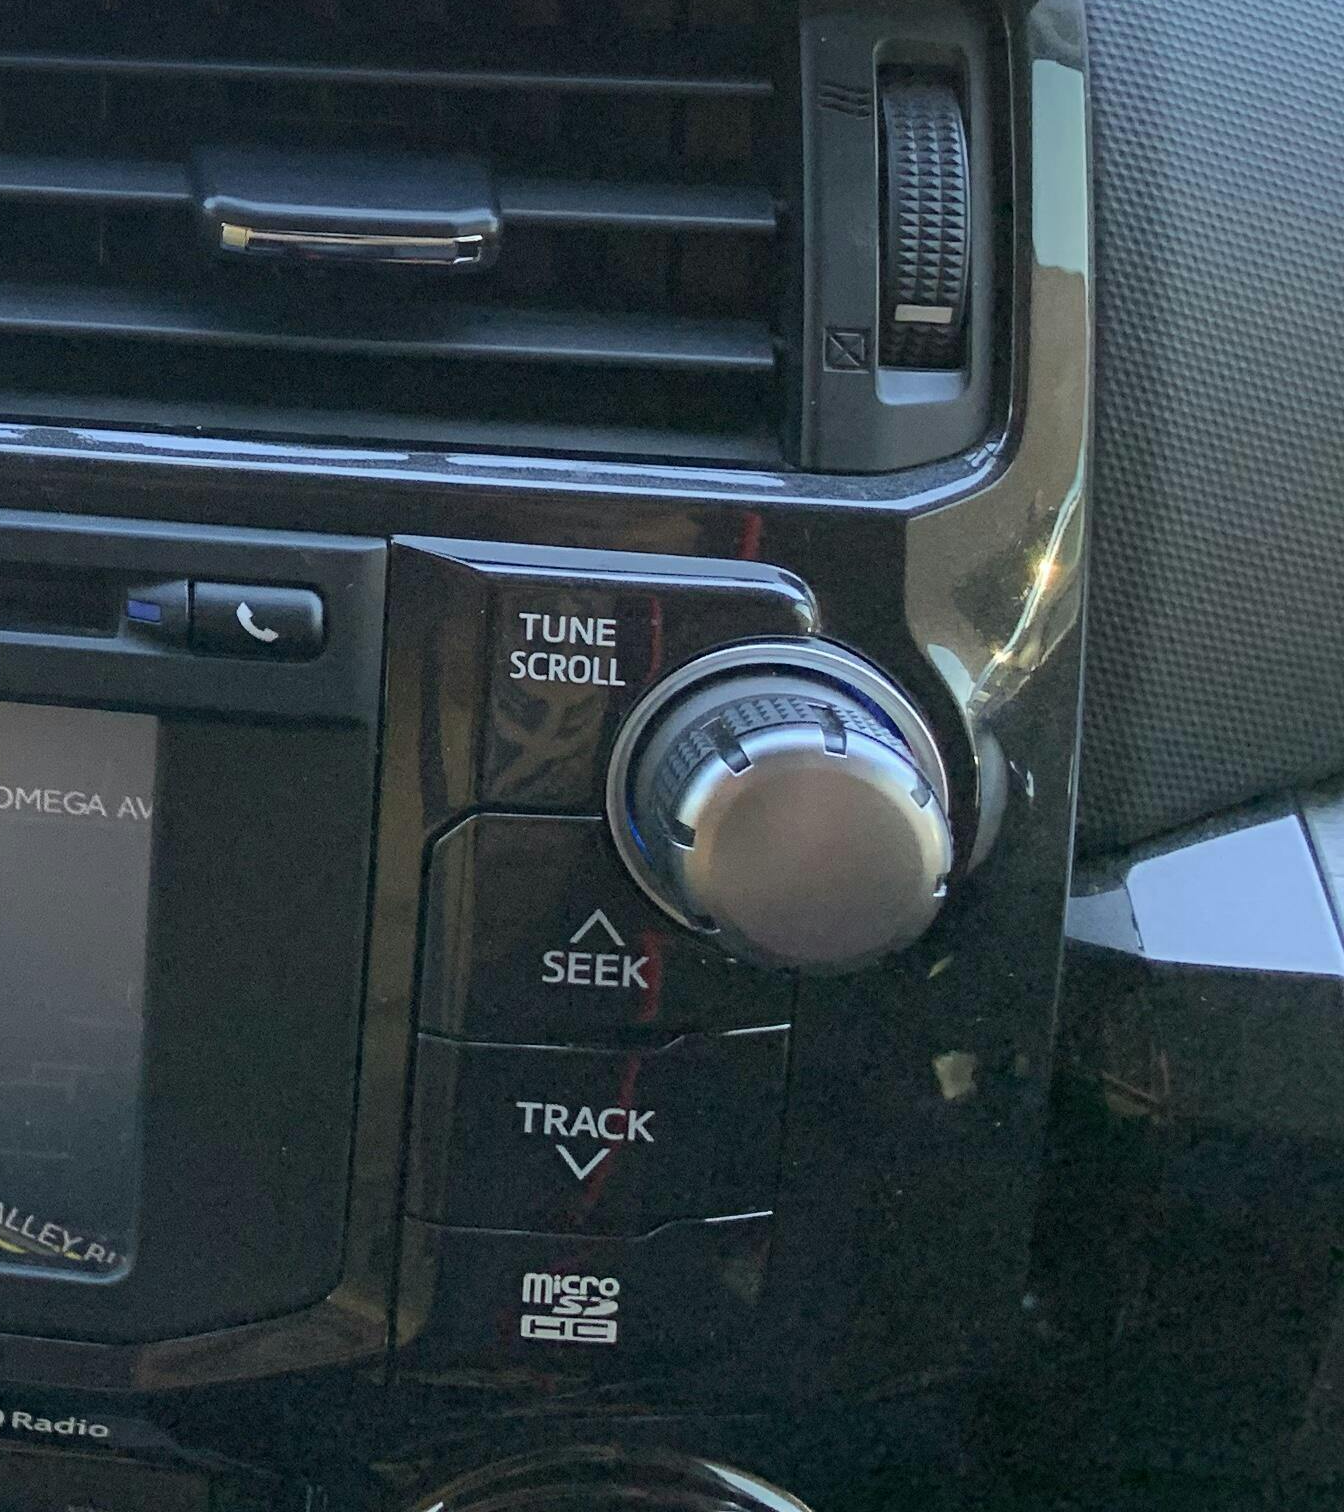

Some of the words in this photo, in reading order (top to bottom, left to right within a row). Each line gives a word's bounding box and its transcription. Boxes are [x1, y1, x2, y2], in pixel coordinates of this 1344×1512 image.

[519, 612, 617, 647] TUNE
[509, 651, 626, 687] SCROLL
[541, 950, 650, 989] SEEK
[516, 1101, 655, 1143] TRACK
[11, 1411, 111, 1438] Radio
